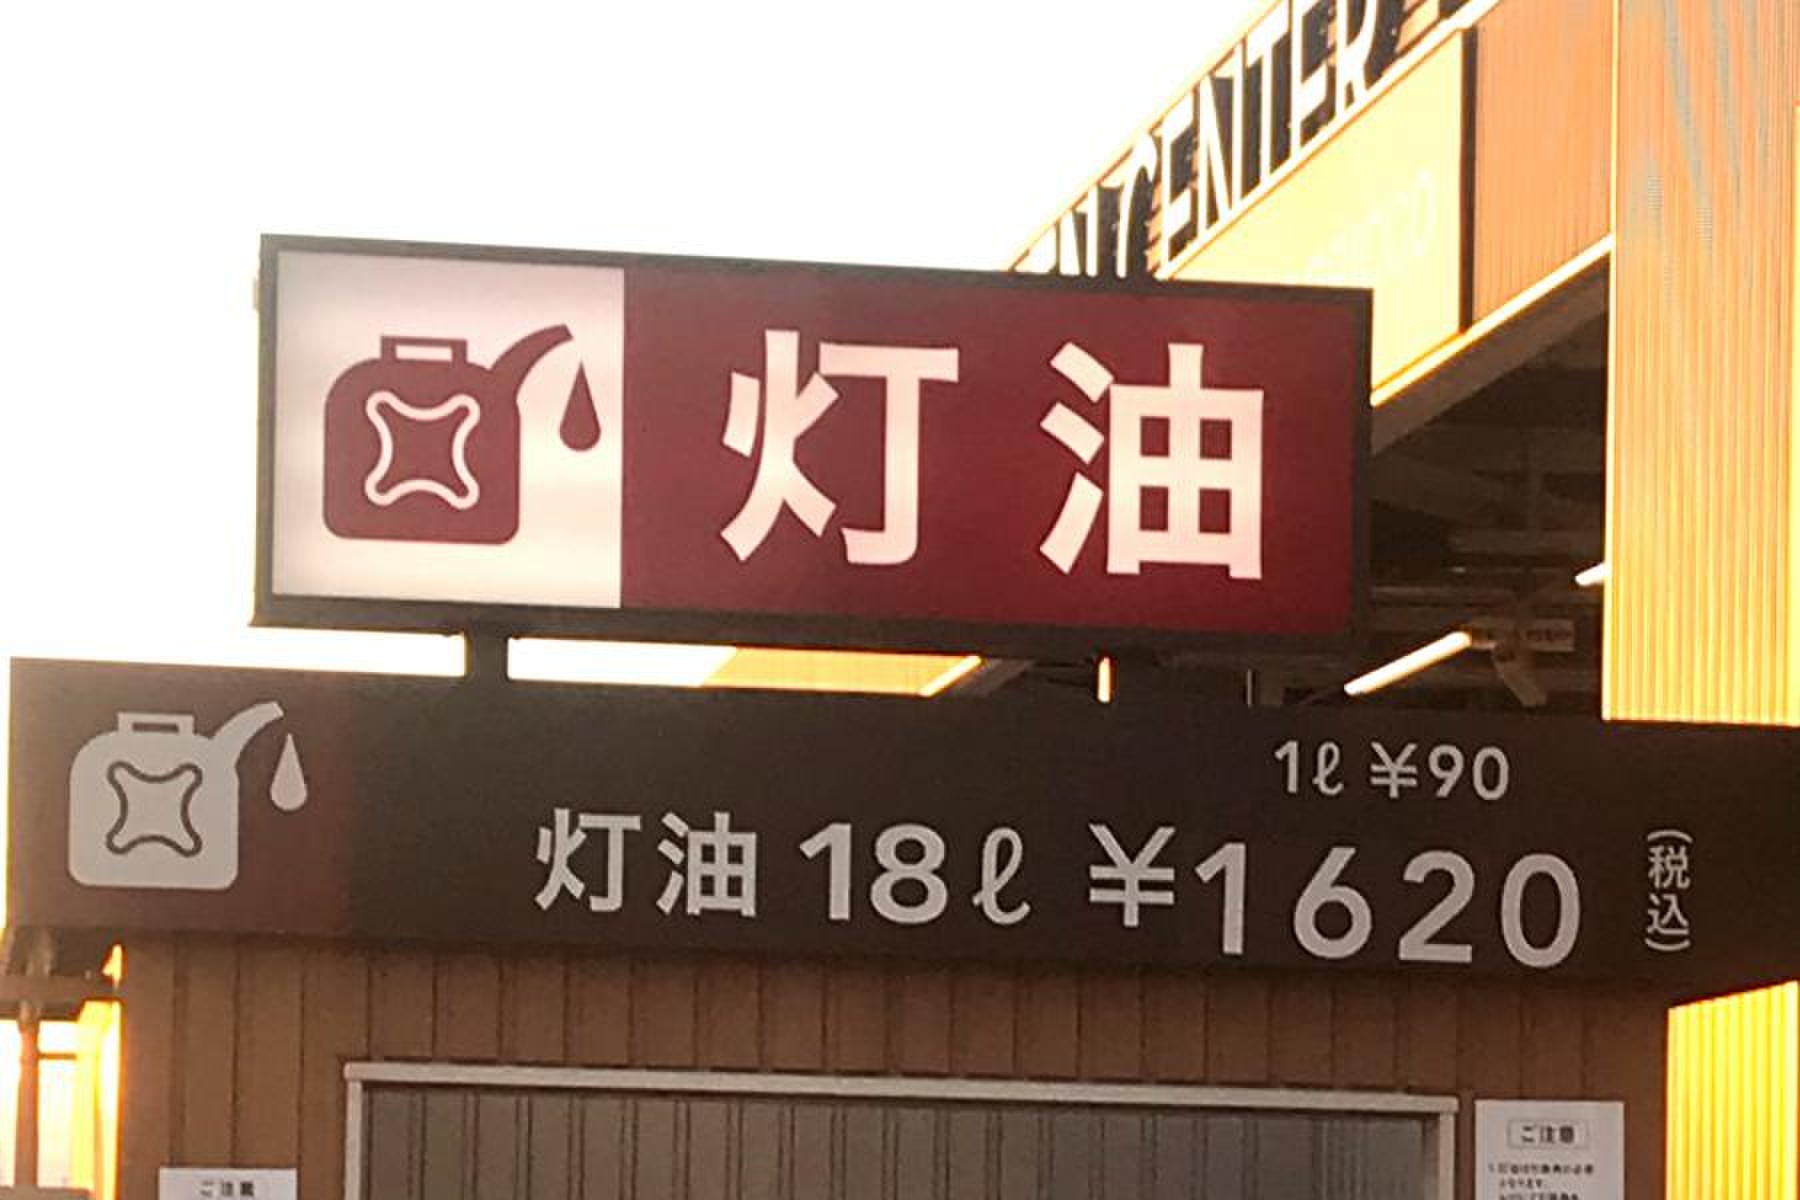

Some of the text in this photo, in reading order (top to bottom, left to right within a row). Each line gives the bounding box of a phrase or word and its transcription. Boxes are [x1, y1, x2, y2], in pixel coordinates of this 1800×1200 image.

[719, 329, 1266, 580] 灯油
[1369, 742, 1511, 801] ¥90
[533, 806, 758, 918] 灯油
[1087, 822, 1582, 969] ¥1620
